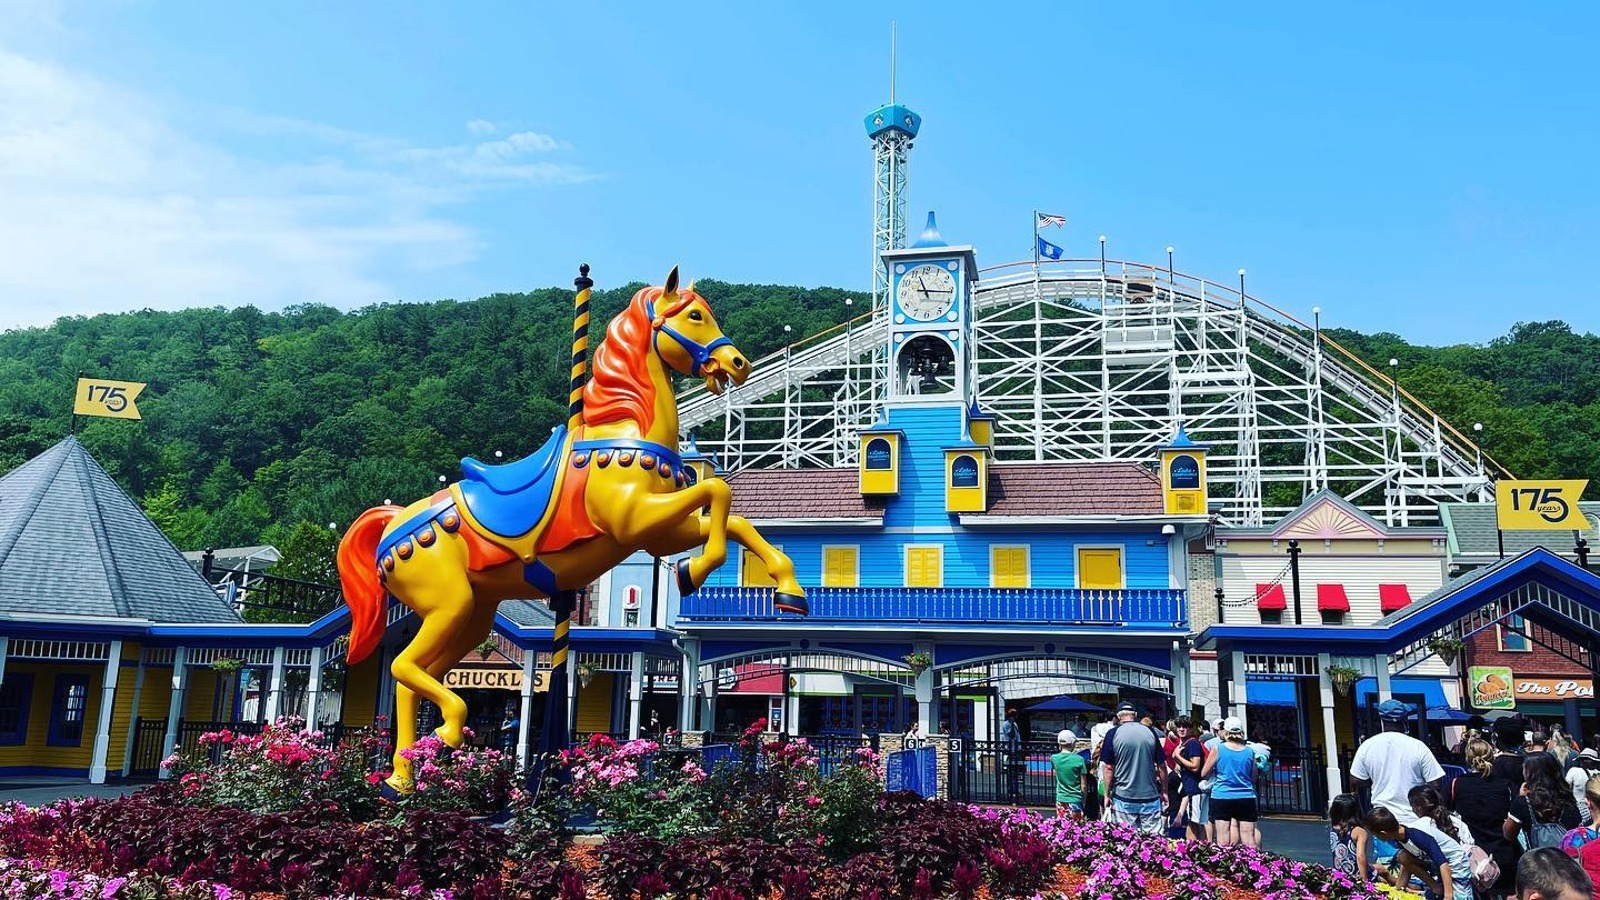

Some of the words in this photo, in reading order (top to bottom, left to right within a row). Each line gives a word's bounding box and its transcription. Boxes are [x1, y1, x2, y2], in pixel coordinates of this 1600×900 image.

[911, 270, 918, 278] 11
[922, 266, 930, 275] 12
[902, 279, 911, 287] 10
[944, 275, 950, 283] 2
[901, 291, 907, 299] 9
[904, 302, 909, 310] 8
[913, 309, 919, 317] 7
[936, 307, 942, 315] 5
[88, 385, 127, 412] 175
[1511, 488, 1569, 523] 175
[446, 671, 543, 687] CHUCKLS
[1517, 682, 1551, 694] The
[908, 740, 914, 749] 6
[951, 740, 958, 750] 5
